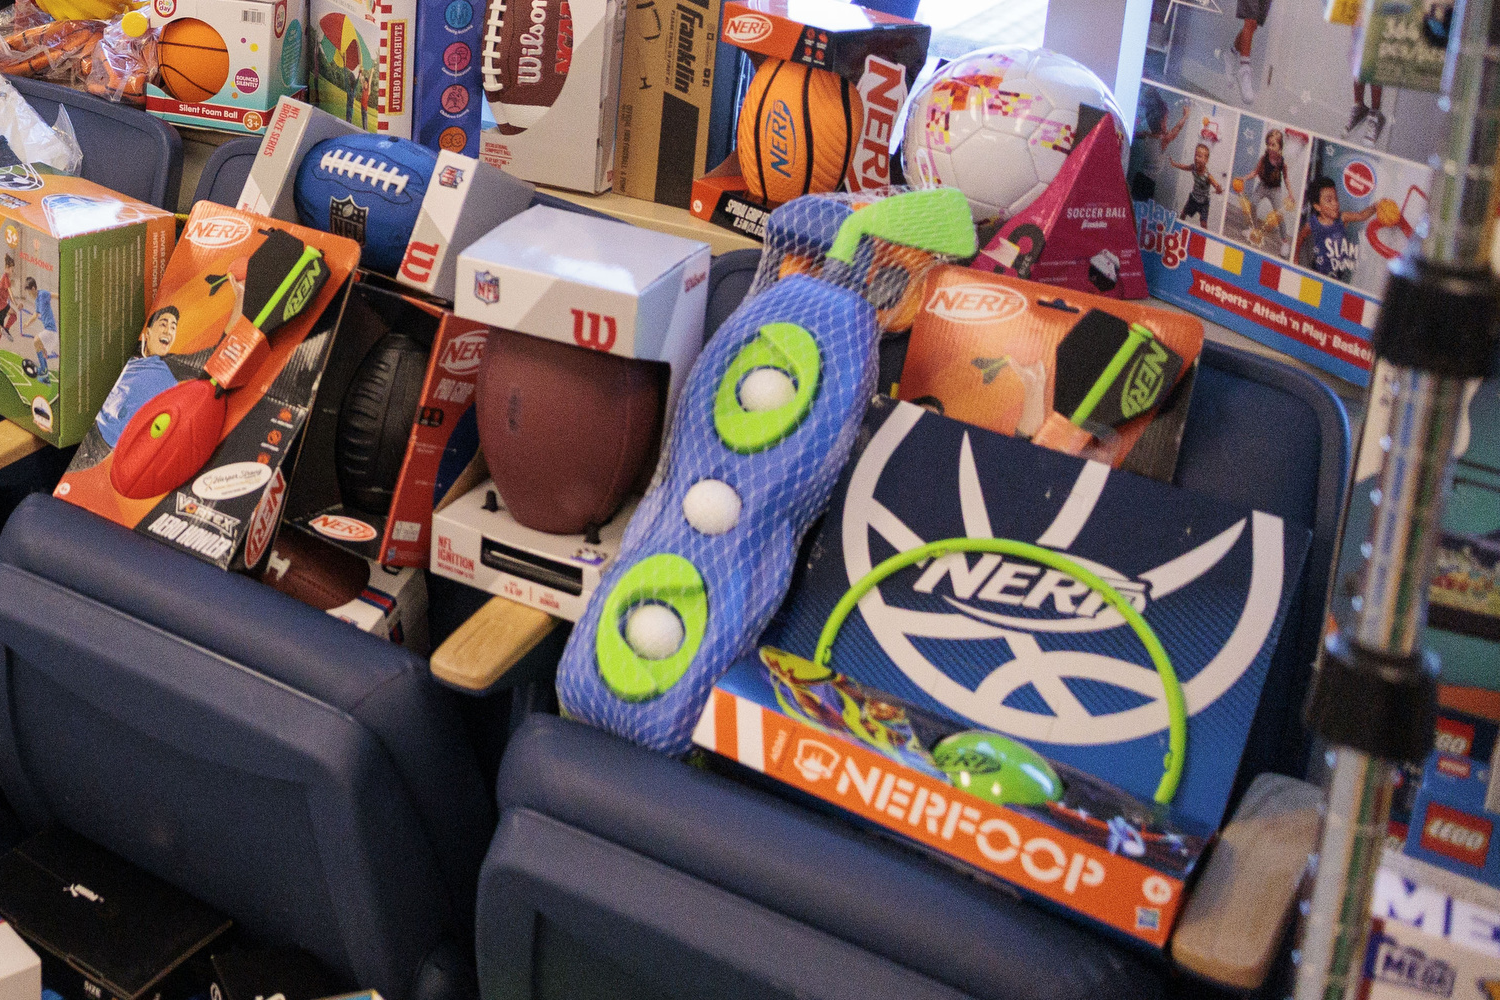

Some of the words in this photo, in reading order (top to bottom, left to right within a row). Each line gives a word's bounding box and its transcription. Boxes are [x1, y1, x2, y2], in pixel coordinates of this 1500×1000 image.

[727, 18, 771, 38] NERF
[395, 24, 403, 77] PARACHUTE
[675, 2, 703, 94] Franklin
[236, 76, 259, 84] BOUNCES
[236, 81, 258, 89] SILENTLY
[395, 79, 403, 110] JUMBO
[179, 104, 200, 114] Silent
[202, 107, 222, 117] Foam
[223, 109, 238, 119] Ball
[770, 100, 797, 178] NERF
[1067, 207, 1101, 219] SOCCER
[1103, 208, 1127, 219] BALL
[188, 219, 249, 242] NERF
[1140, 226, 1191, 268] big!
[928, 287, 1022, 316] NERF
[314, 517, 375, 539] NERF
[837, 763, 1106, 895] NERFOOP
